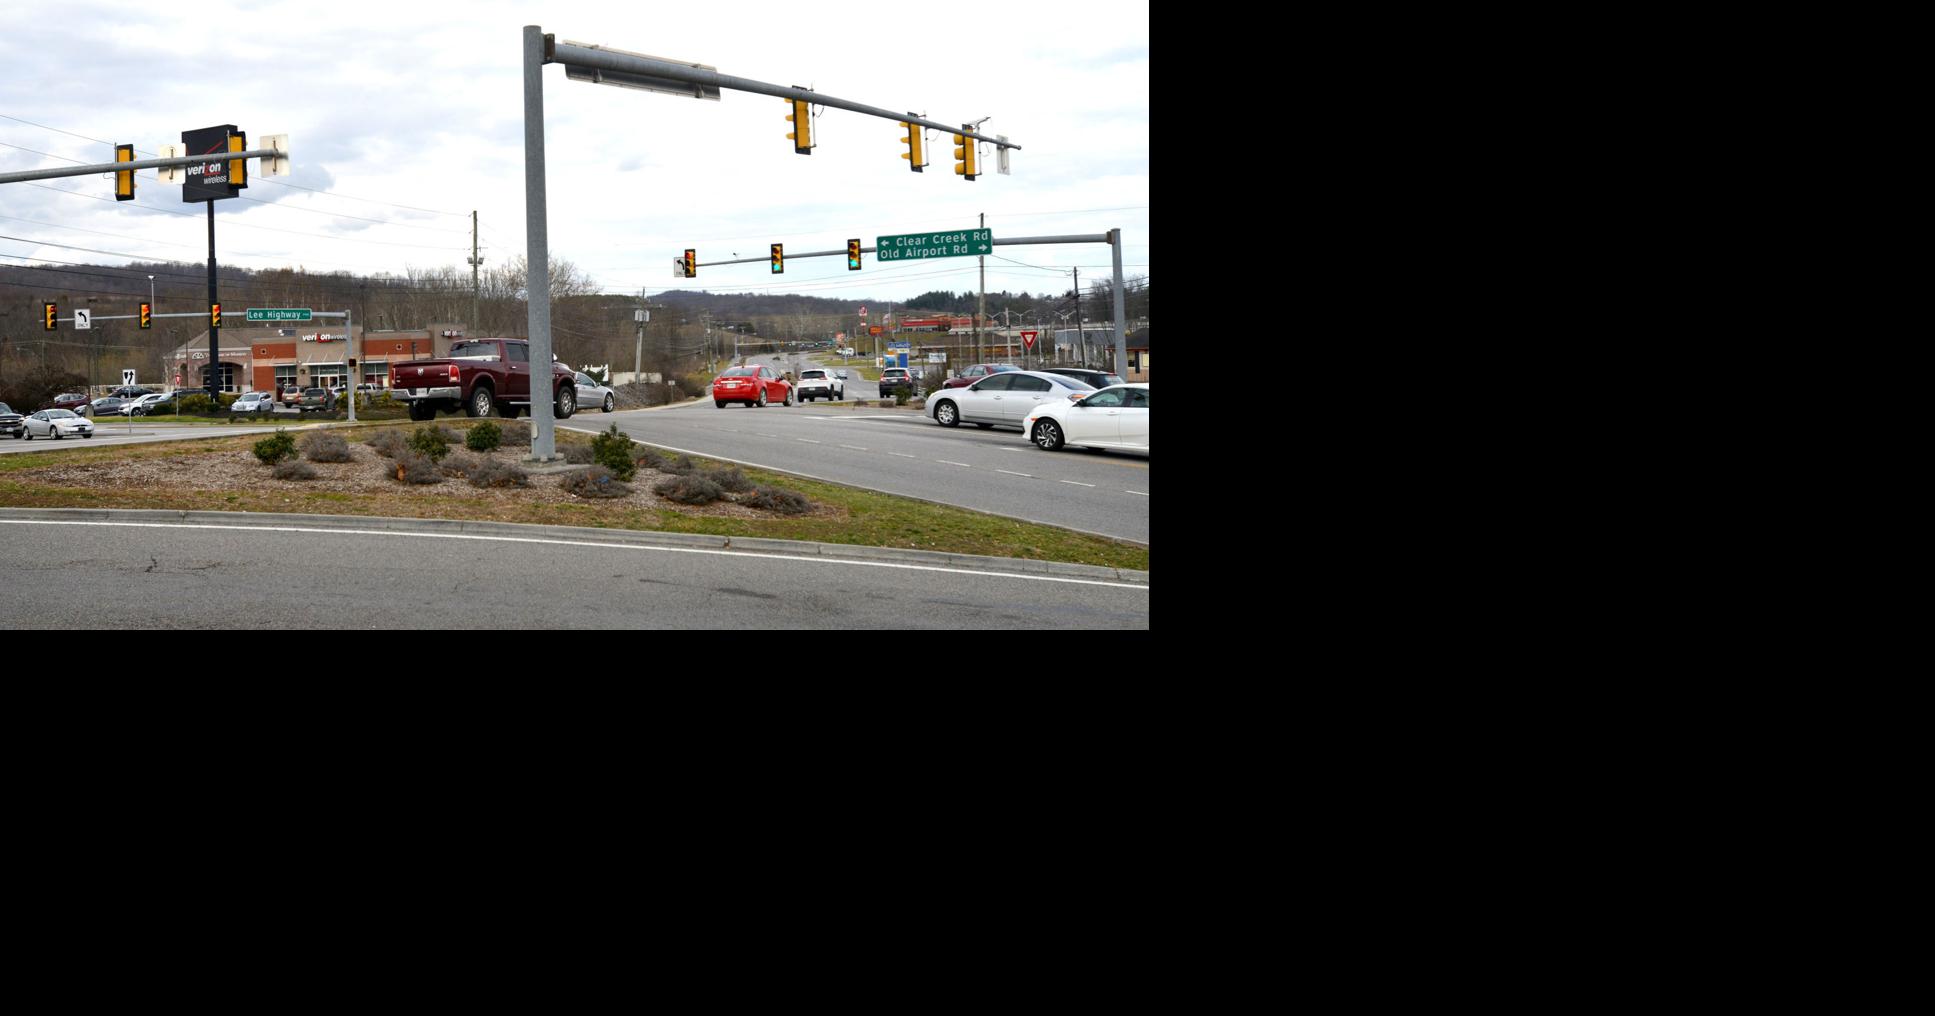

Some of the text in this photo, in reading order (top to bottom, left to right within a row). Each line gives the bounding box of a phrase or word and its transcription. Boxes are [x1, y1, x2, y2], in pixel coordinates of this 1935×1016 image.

[187, 162, 221, 176] verizon
[203, 175, 227, 184] wireless
[896, 230, 988, 247] Clear Creek Rd
[880, 244, 968, 259] Old Airport Rd
[248, 310, 301, 320] Lee Highway
[302, 332, 332, 344] verizon
